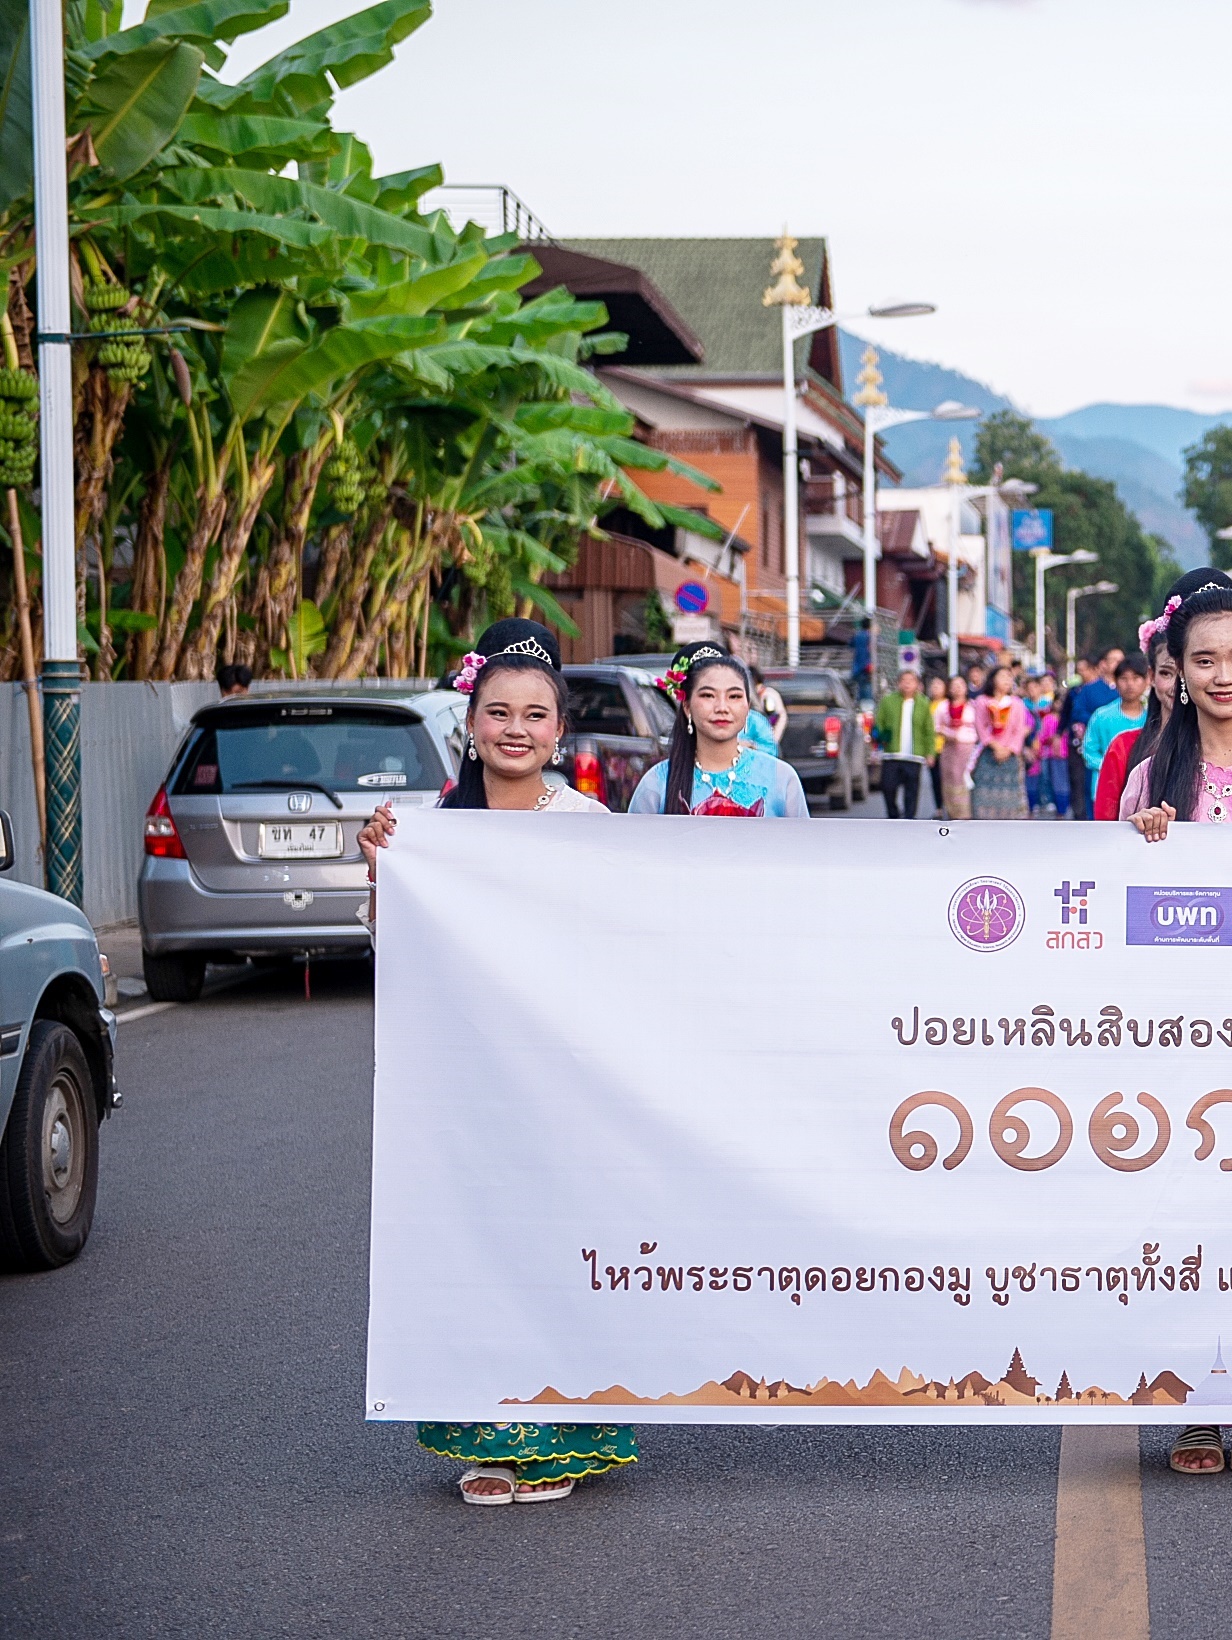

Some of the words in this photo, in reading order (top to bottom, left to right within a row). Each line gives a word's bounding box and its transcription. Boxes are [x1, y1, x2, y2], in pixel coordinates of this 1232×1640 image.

[309, 826, 325, 840] 47
[1157, 906, 1217, 926] บพท
[1046, 931, 1103, 949] สกสว
[582, 1241, 971, 1307] ไหว้พระธาตุดอยกองมู
[985, 1242, 1202, 1307] บูชาธาตุทั้งสี่
